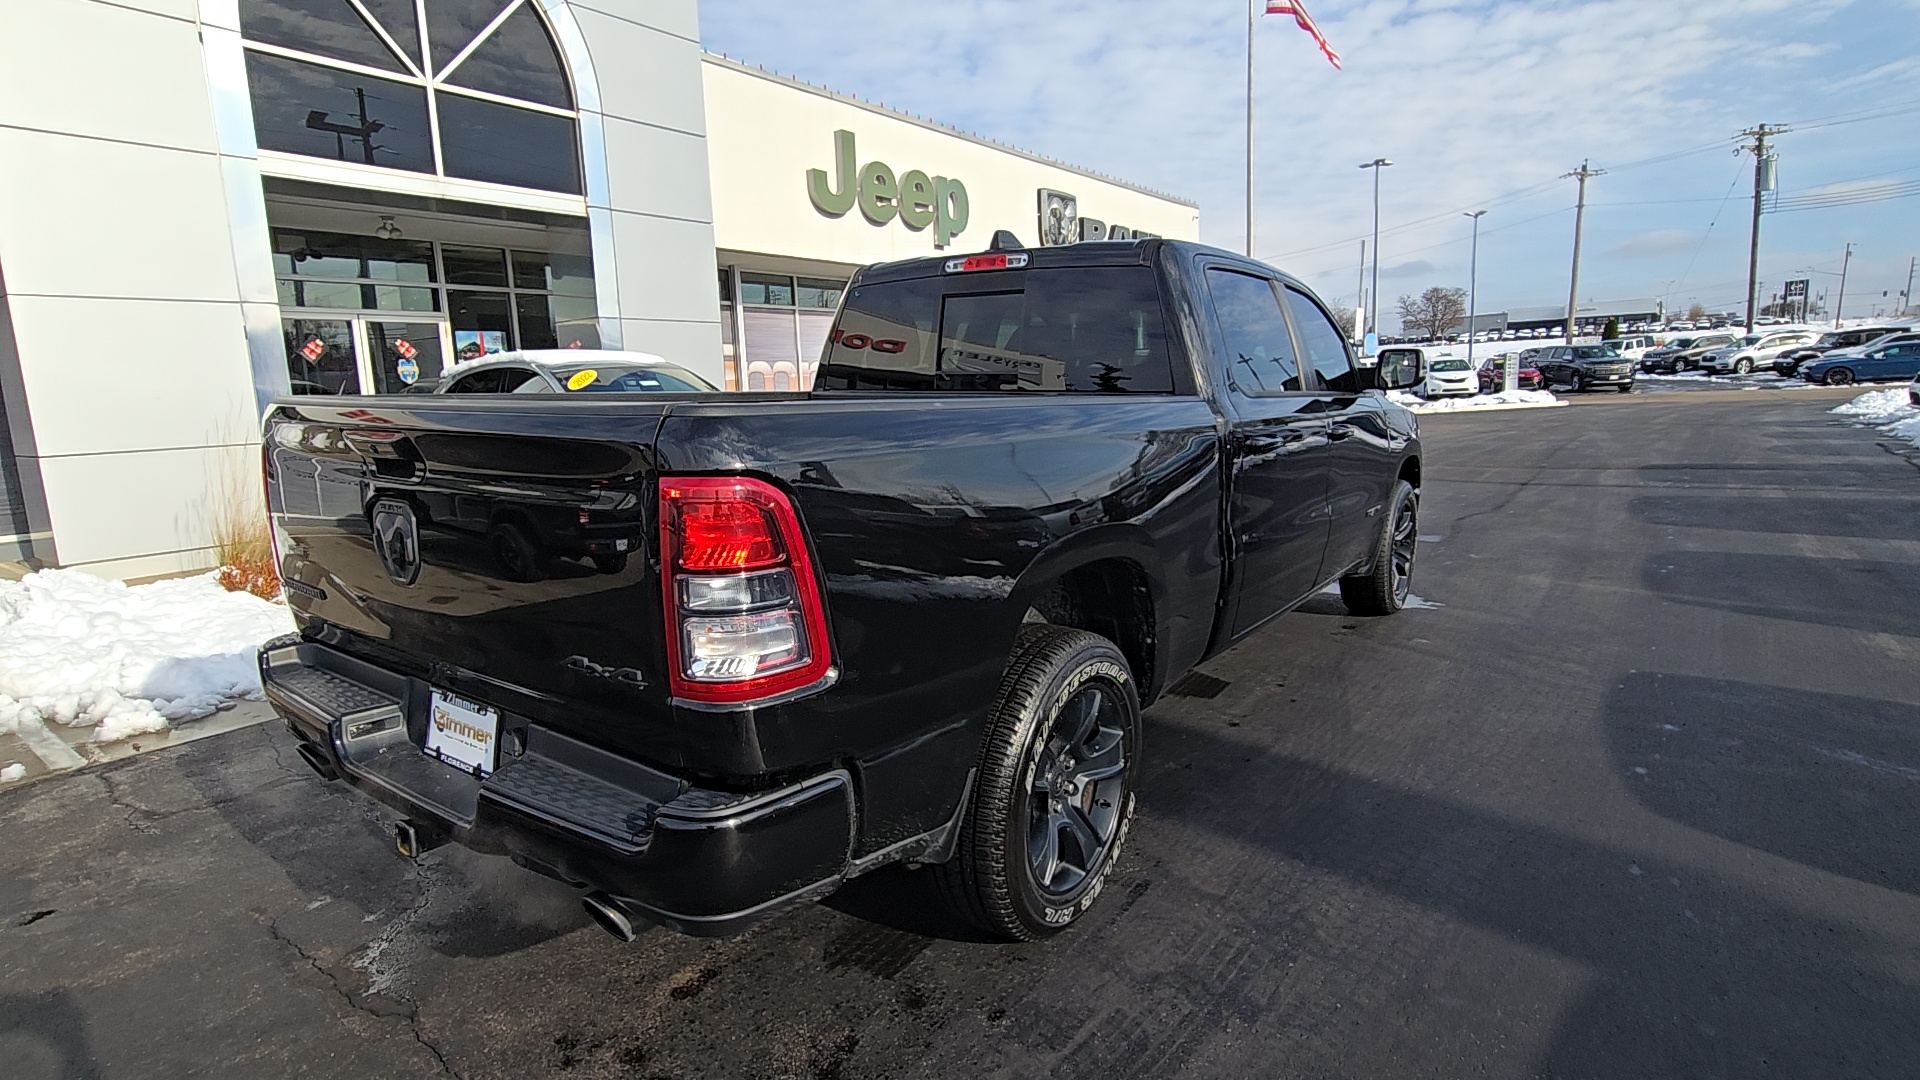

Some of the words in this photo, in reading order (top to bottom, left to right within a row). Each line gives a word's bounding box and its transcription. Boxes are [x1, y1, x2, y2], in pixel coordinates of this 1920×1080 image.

[806, 129, 969, 249] Jeep
[446, 691, 480, 713] Zimmer
[434, 708, 493, 745] Zimmer
